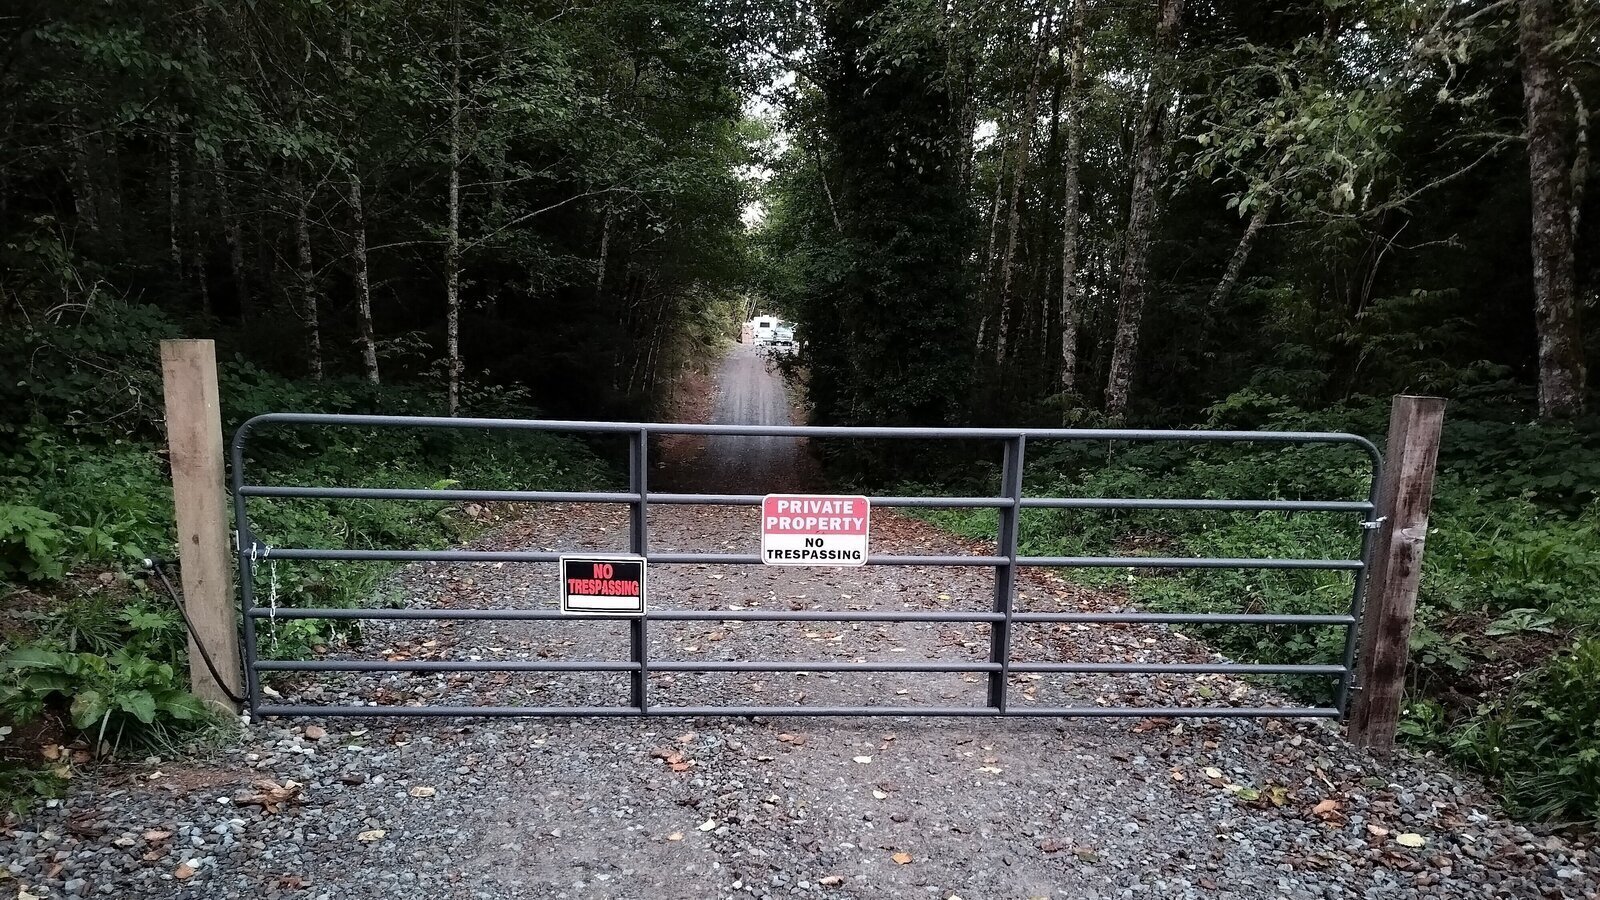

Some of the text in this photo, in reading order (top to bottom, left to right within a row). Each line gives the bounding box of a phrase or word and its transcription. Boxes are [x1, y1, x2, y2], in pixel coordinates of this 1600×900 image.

[777, 500, 854, 514] PRIVATE
[766, 516, 864, 530] PROPERTY
[805, 538, 824, 547] NO
[767, 549, 861, 560] TRESPASSING
[593, 563, 613, 579] NO
[568, 578, 639, 595] TRESPASSING
